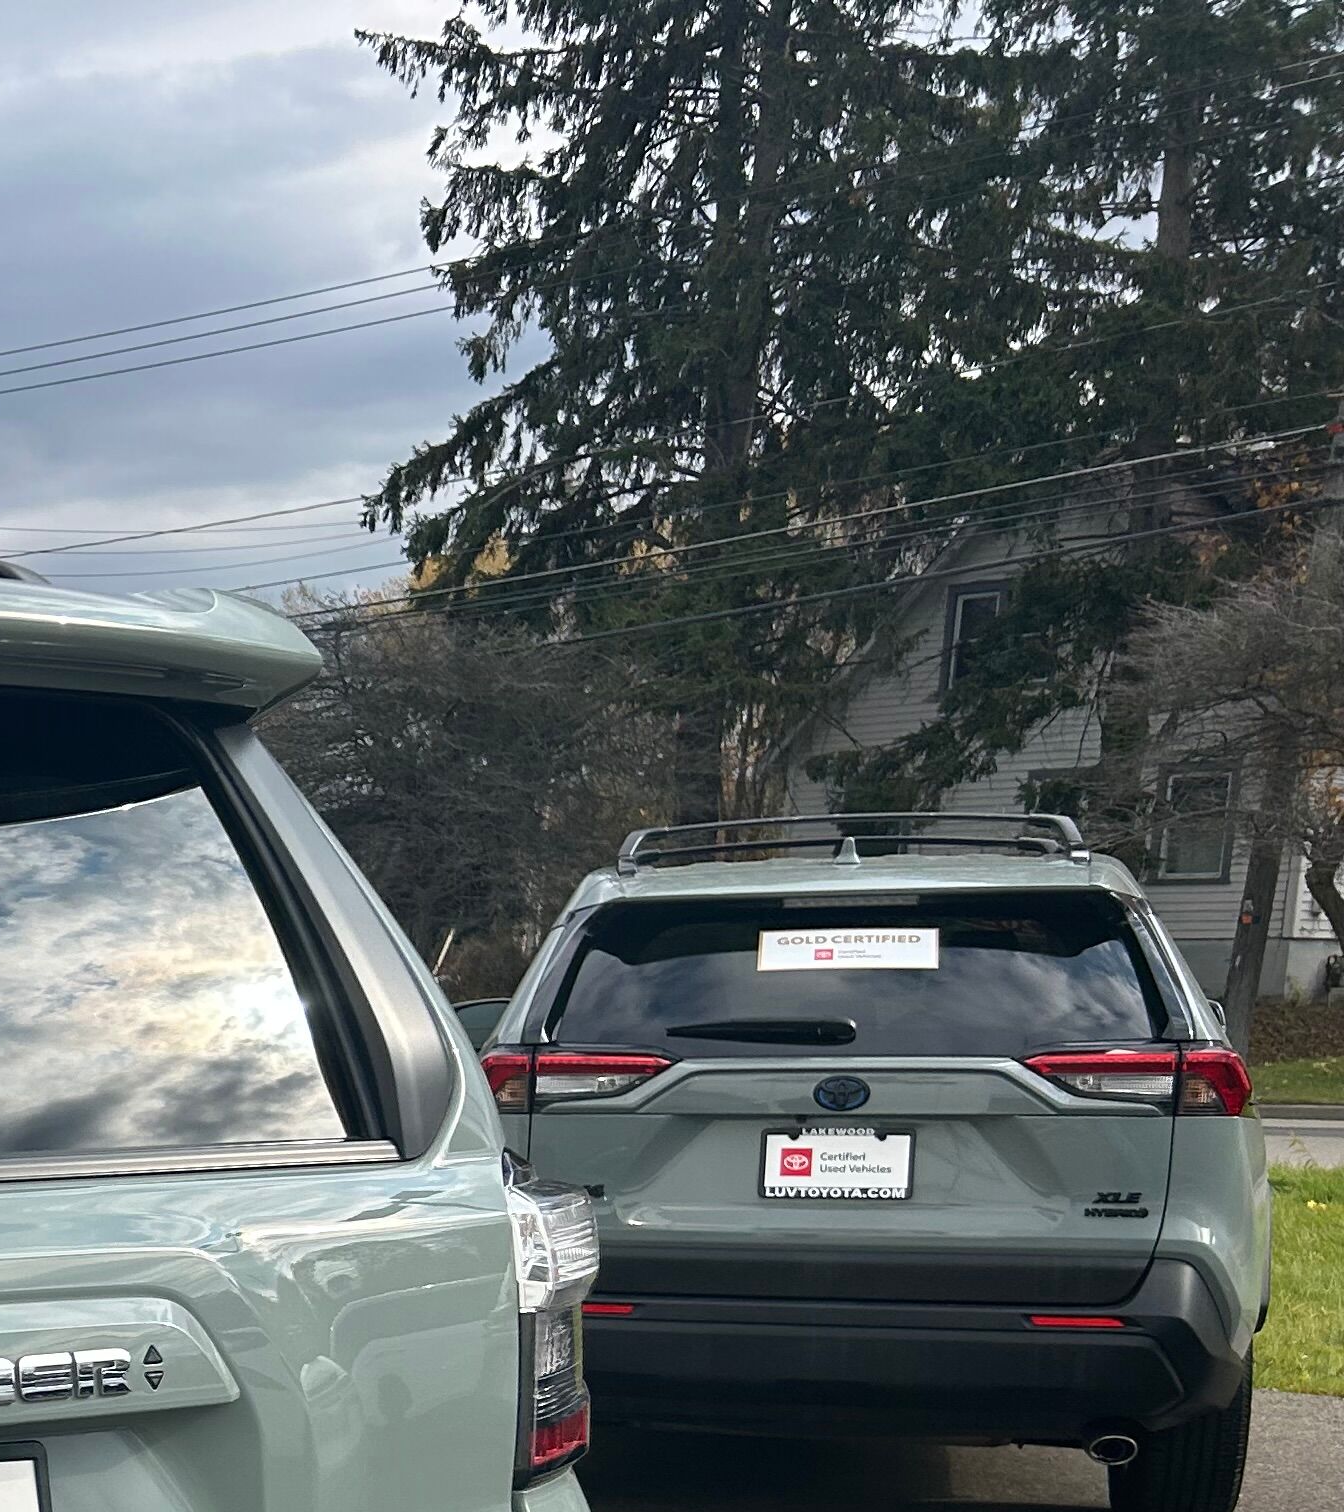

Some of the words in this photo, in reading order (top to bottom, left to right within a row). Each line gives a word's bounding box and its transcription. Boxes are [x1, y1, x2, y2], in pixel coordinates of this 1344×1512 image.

[777, 935, 827, 946] GOLD
[830, 934, 921, 945] CERTIFIED
[802, 1127, 875, 1136] LAKEWOOD
[819, 1151, 866, 1162] Certified
[819, 1164, 846, 1174] Used
[849, 1164, 892, 1174] Vehicles
[765, 1186, 906, 1199] LUVTOYOTA.COM
